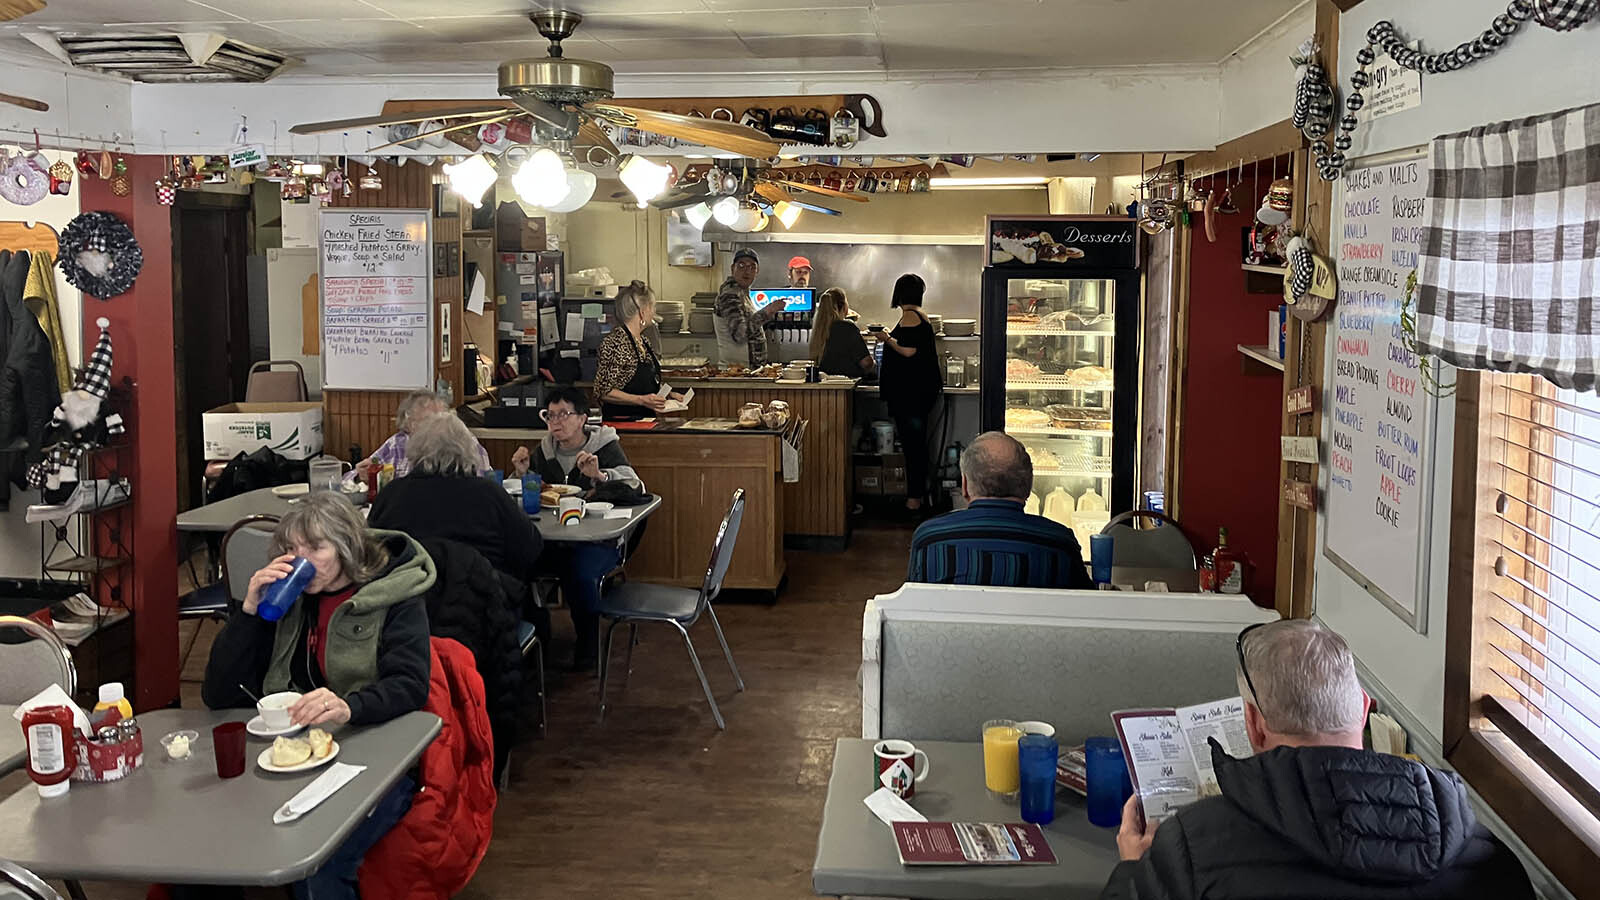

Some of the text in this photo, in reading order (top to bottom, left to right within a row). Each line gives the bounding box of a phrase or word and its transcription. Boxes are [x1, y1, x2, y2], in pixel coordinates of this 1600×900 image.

[1346, 163, 1418, 192] SHAKES AND MALTS
[1345, 197, 1380, 218] CHOCOLATE
[1063, 226, 1133, 243] Desserts
[1344, 224, 1368, 239] VANILLA
[1391, 226, 1409, 243] IRISH
[1342, 243, 1384, 261] STRAWBERRY
[1341, 266, 1362, 284] ORANGE
[1340, 289, 1362, 307] PEANUT
[1340, 312, 1375, 335] BLUEBERRY
[1337, 335, 1369, 357] CINNAMON
[1387, 341, 1419, 369] CARAMEL
[1336, 359, 1379, 391] BREAD PUDDING
[1386, 368, 1417, 399] CHERRY
[1335, 384, 1356, 406] MAPLE
[1335, 406, 1364, 433] PINEAPPLE
[1386, 396, 1413, 424] ALMOND
[1333, 430, 1353, 454] MOCHA
[1377, 421, 1419, 459] BUTTER RUM
[1332, 450, 1353, 476] PEACH
[1397, 460, 1417, 487] LOOPS
[1380, 472, 1401, 505] APPLE
[1375, 496, 1400, 528] COOKIE
